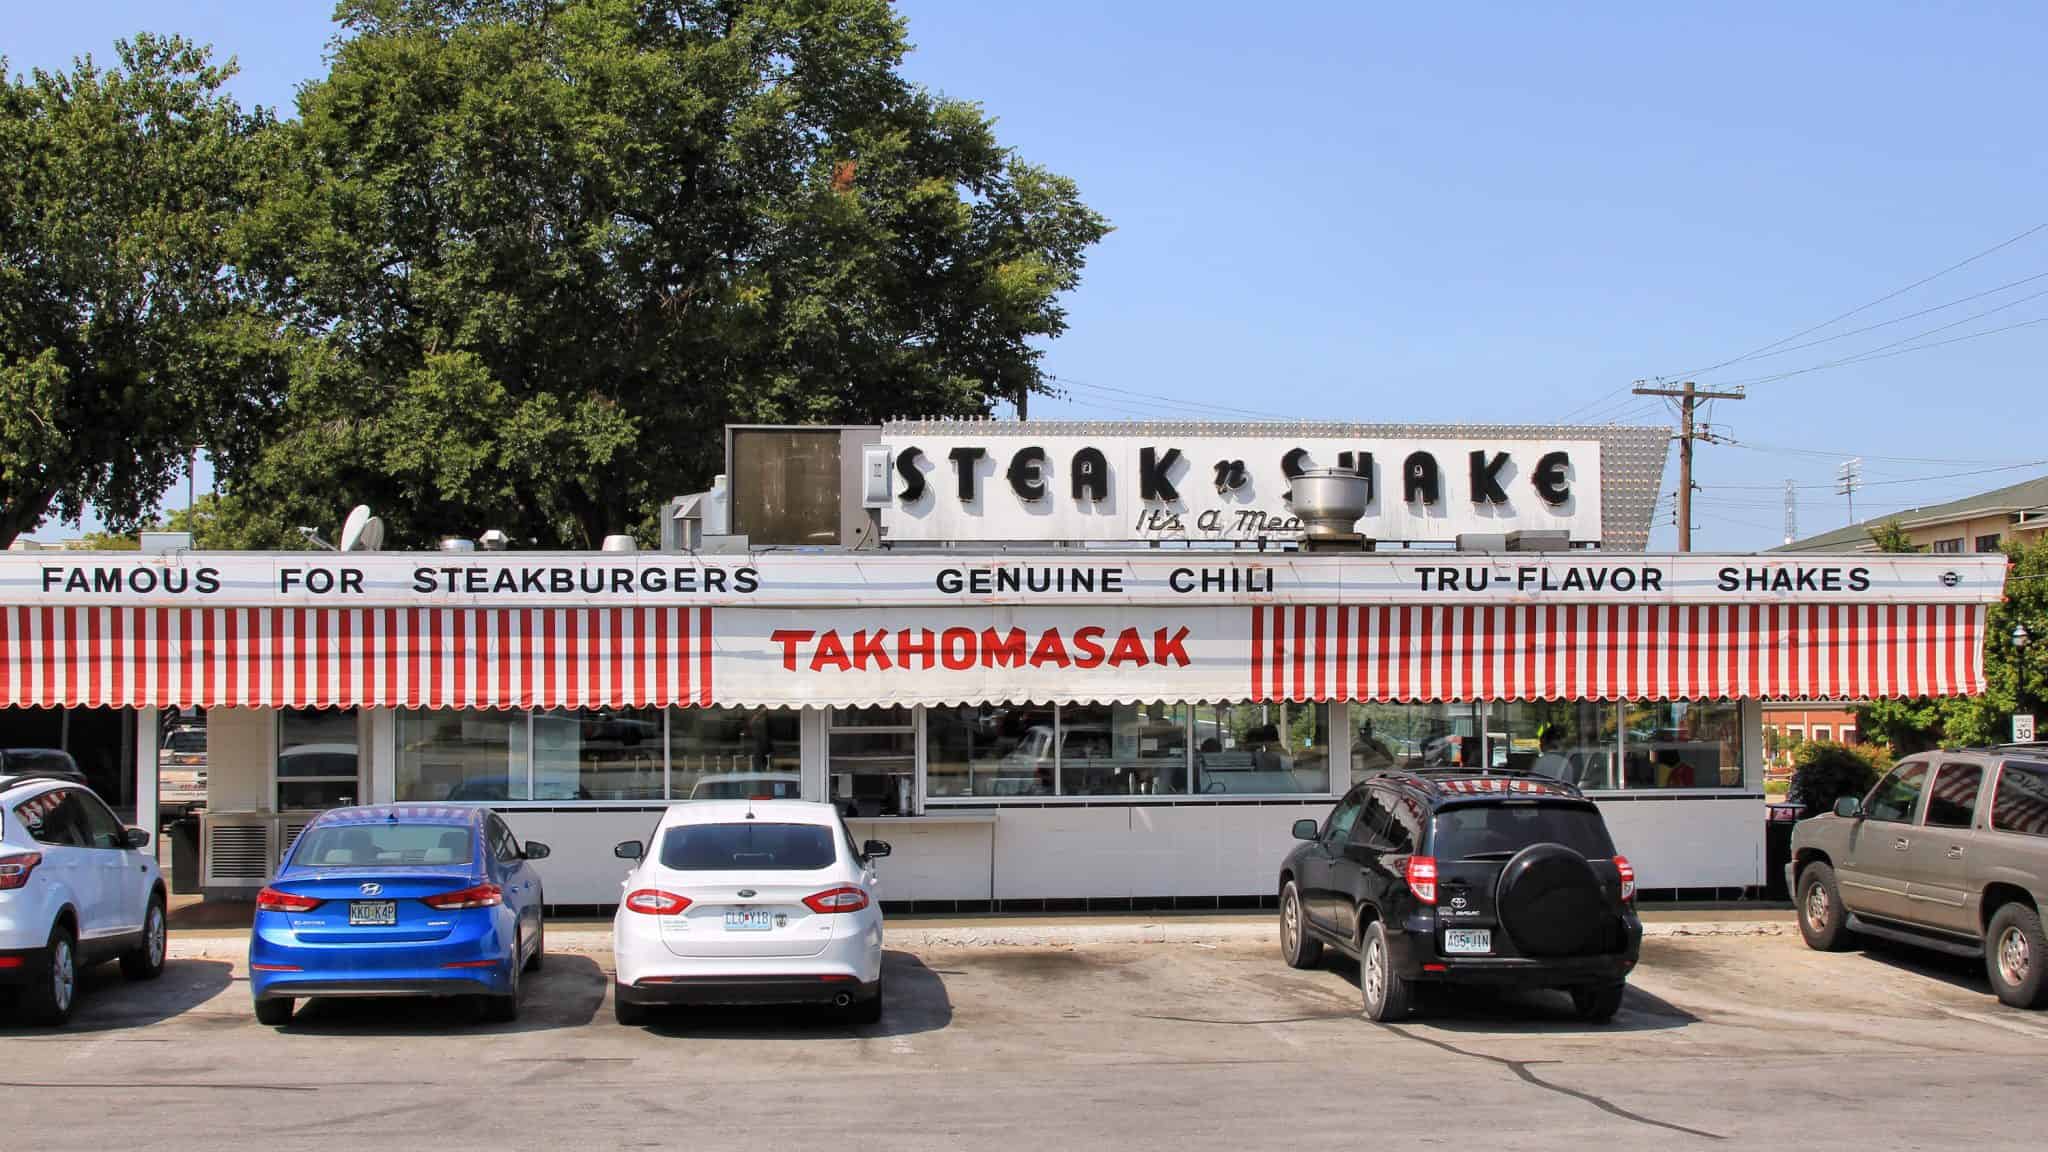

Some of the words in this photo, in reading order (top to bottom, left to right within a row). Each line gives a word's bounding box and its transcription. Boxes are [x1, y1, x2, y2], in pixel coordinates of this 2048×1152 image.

[896, 446, 1181, 503] STEAK
[1214, 460, 1247, 495] n
[1234, 510, 1304, 531] Mea
[43, 567, 220, 594] FAMOUS
[281, 568, 363, 594] FOR
[414, 567, 758, 594] STEAKBURGERS
[936, 567, 1123, 594] GENUINE
[1169, 567, 1273, 594] CHILI
[1418, 567, 1663, 594] TRU-FLAVOR
[1718, 567, 1871, 594] SHAKES
[771, 626, 1191, 672] TAKHOMASAK
[2015, 728, 2031, 739] 30
